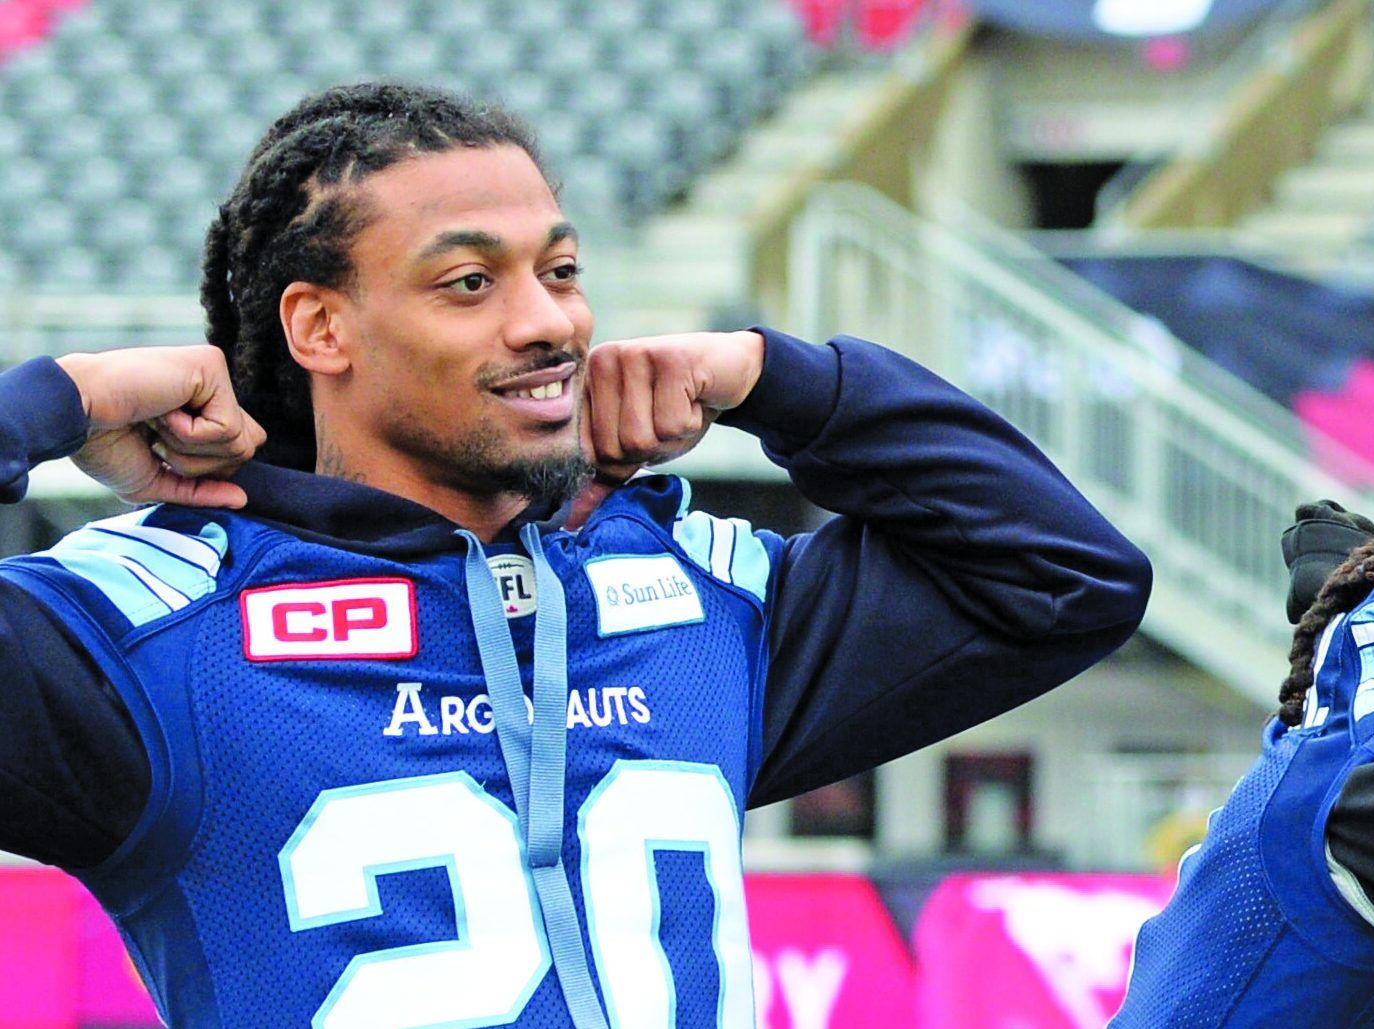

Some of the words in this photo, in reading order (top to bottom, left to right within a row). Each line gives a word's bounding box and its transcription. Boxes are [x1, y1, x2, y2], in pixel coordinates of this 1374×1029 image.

[496, 575, 532, 601] FL
[621, 583, 659, 605] Sun
[661, 576, 693, 598] Life
[272, 598, 388, 642] CP
[382, 682, 651, 737] ARGAUTS
